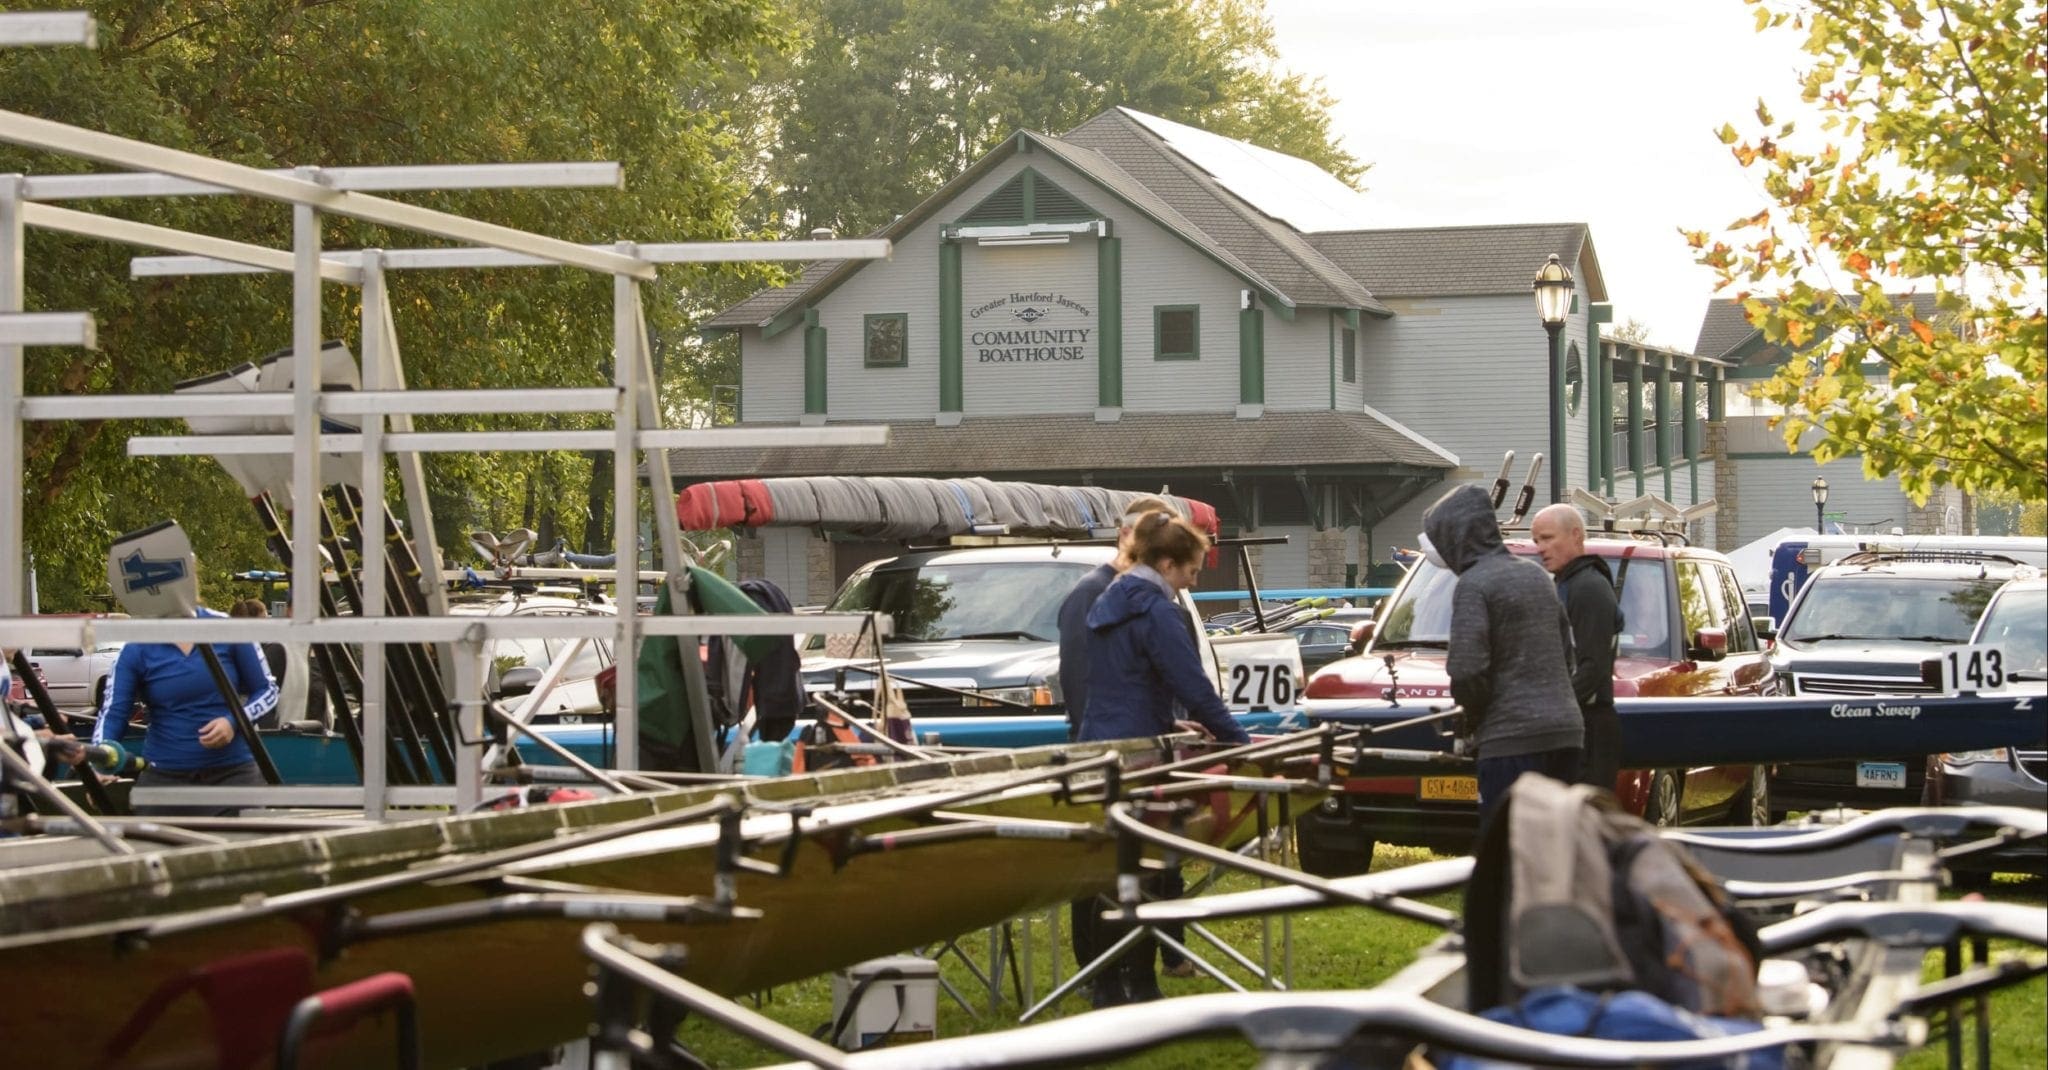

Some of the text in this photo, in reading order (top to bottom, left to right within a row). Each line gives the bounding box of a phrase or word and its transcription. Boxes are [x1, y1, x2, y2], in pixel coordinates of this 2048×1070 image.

[970, 291, 1091, 319] Greater Hartford Jaycees
[971, 329, 1091, 346] COMMUNITY
[978, 346, 1085, 363] BOATHOUSE
[1948, 649, 2004, 690] 143
[1231, 664, 1291, 706] 276
[1830, 702, 1921, 720] Clean Sweep
